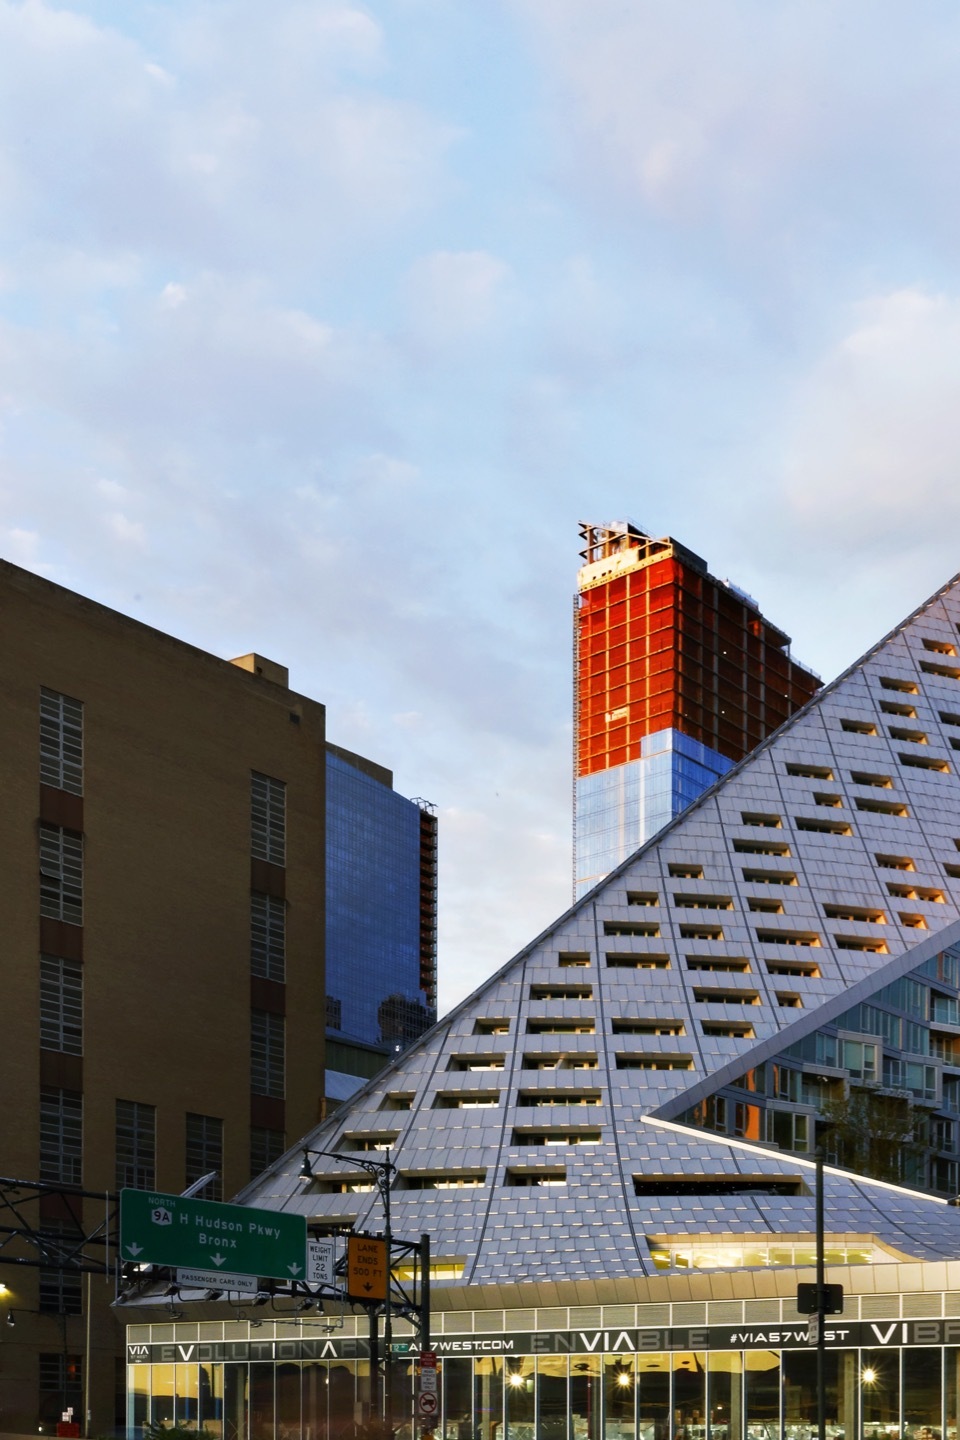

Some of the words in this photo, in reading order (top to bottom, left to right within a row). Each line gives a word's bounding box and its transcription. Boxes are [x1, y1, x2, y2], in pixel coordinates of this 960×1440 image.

[148, 1197, 176, 1207] NORTH
[154, 1210, 170, 1222] 9A
[180, 1213, 188, 1224] H
[195, 1215, 243, 1232] Hudson
[248, 1223, 281, 1240] Pkwy
[199, 1233, 237, 1248] Bronx
[310, 1246, 331, 1254] WEIGHT
[357, 1244, 378, 1253] LANE
[357, 1256, 379, 1265] ENDS
[315, 1263, 326, 1271] 22
[353, 1267, 370, 1276] 500
[181, 1274, 217, 1284] PASSENGER
[313, 1272, 328, 1280] TONS
[530, 1329, 710, 1352] ENVIABLE
[730, 1330, 850, 1343] #VIA57WST
[128, 1346, 149, 1355] VIA
